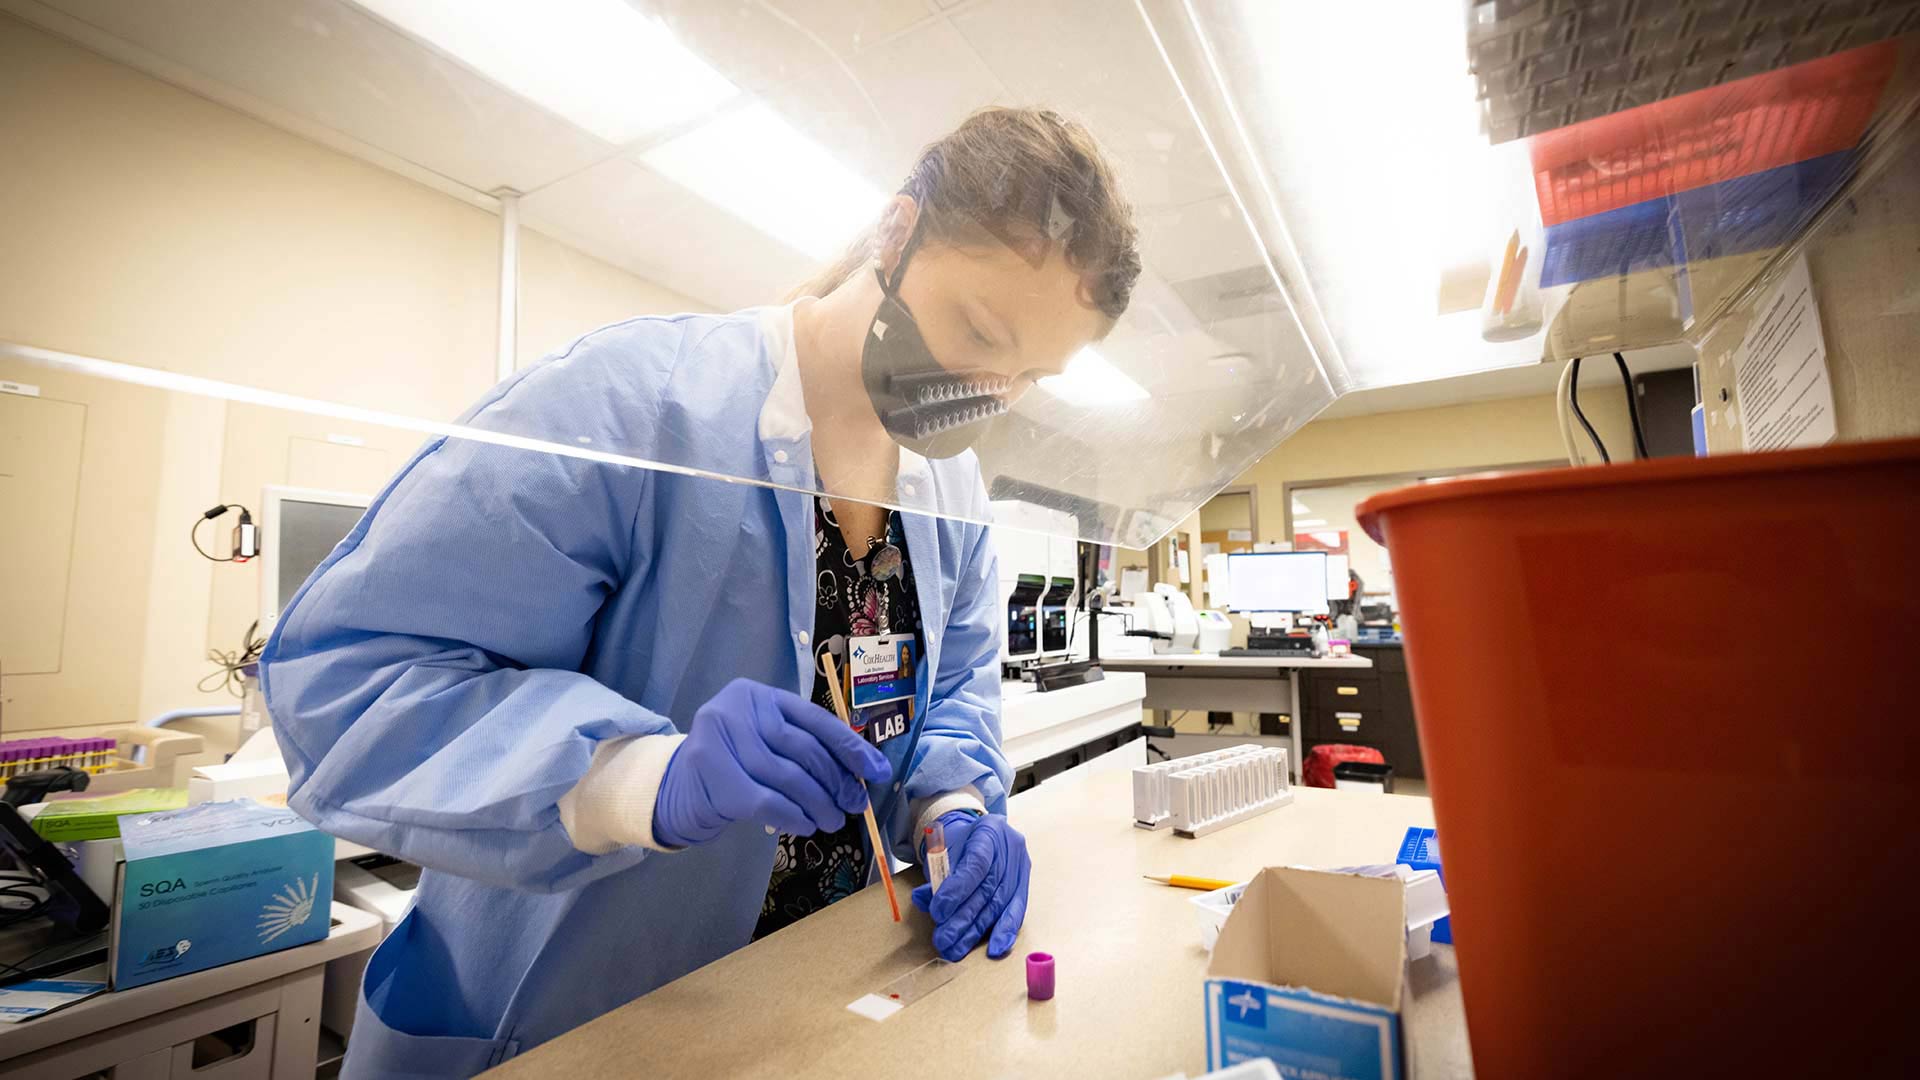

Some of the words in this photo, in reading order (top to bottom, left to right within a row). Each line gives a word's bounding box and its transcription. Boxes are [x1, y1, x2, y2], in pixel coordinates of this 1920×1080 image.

[857, 676, 879, 684] Laboratory
[874, 713, 905, 743] LAB
[139, 877, 186, 897] SQA
